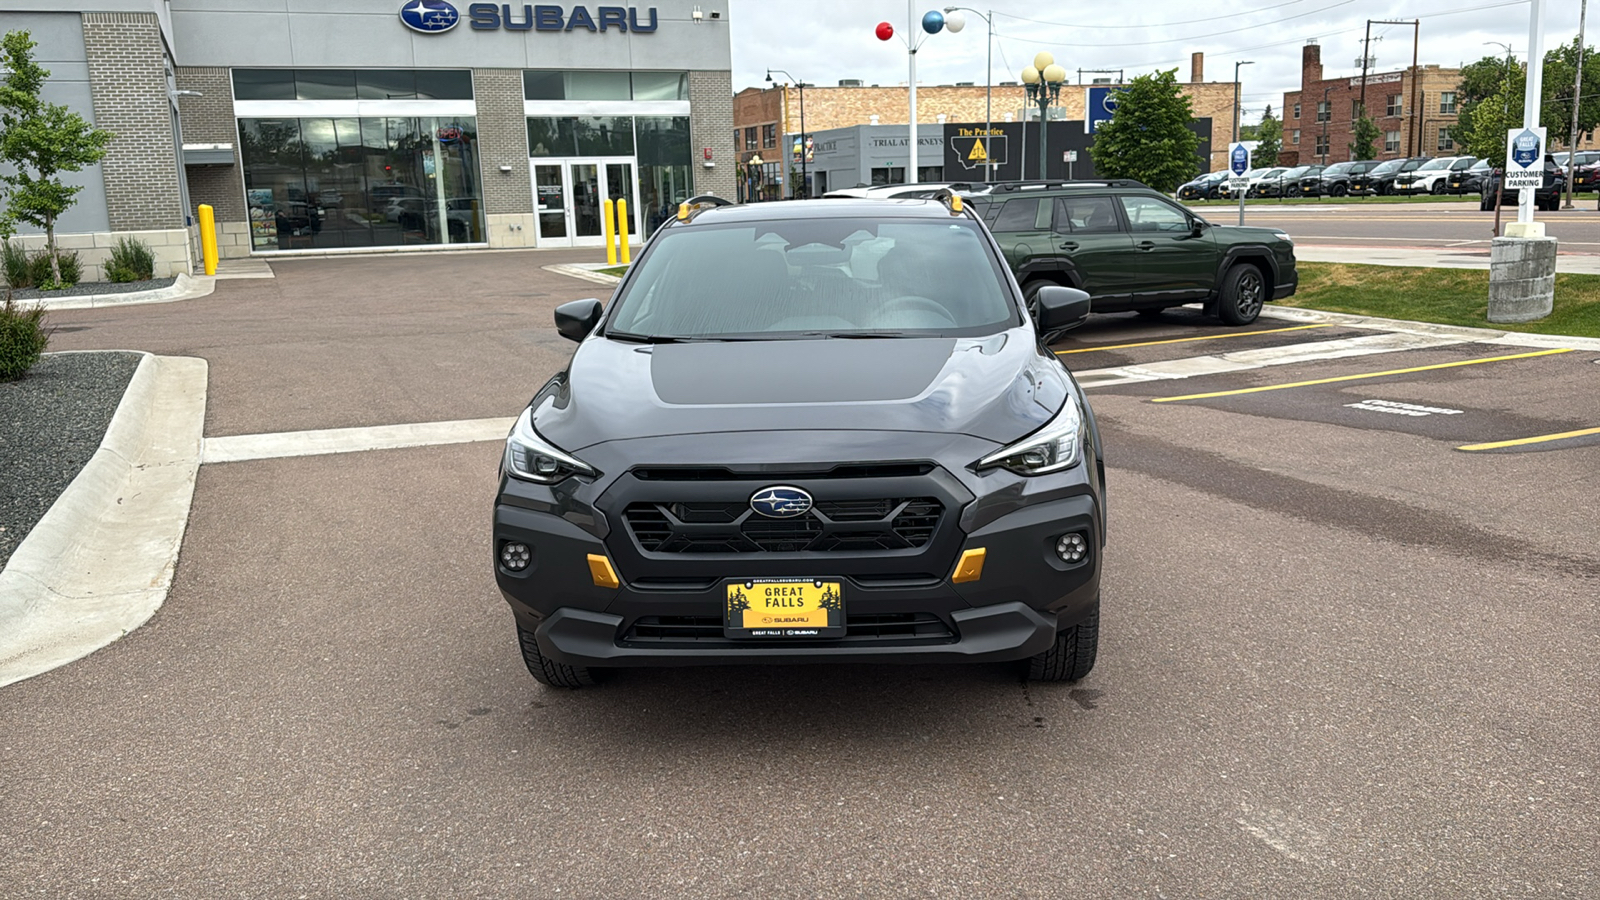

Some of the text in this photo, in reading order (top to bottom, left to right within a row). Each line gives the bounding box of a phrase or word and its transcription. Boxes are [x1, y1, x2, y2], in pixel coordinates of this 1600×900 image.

[469, 3, 658, 33] SUBARU
[958, 127, 1004, 136] The Pratice
[873, 138, 944, 147] TRIAL ATRNEYS
[765, 587, 803, 597] GREAT
[766, 598, 804, 607] FALLS
